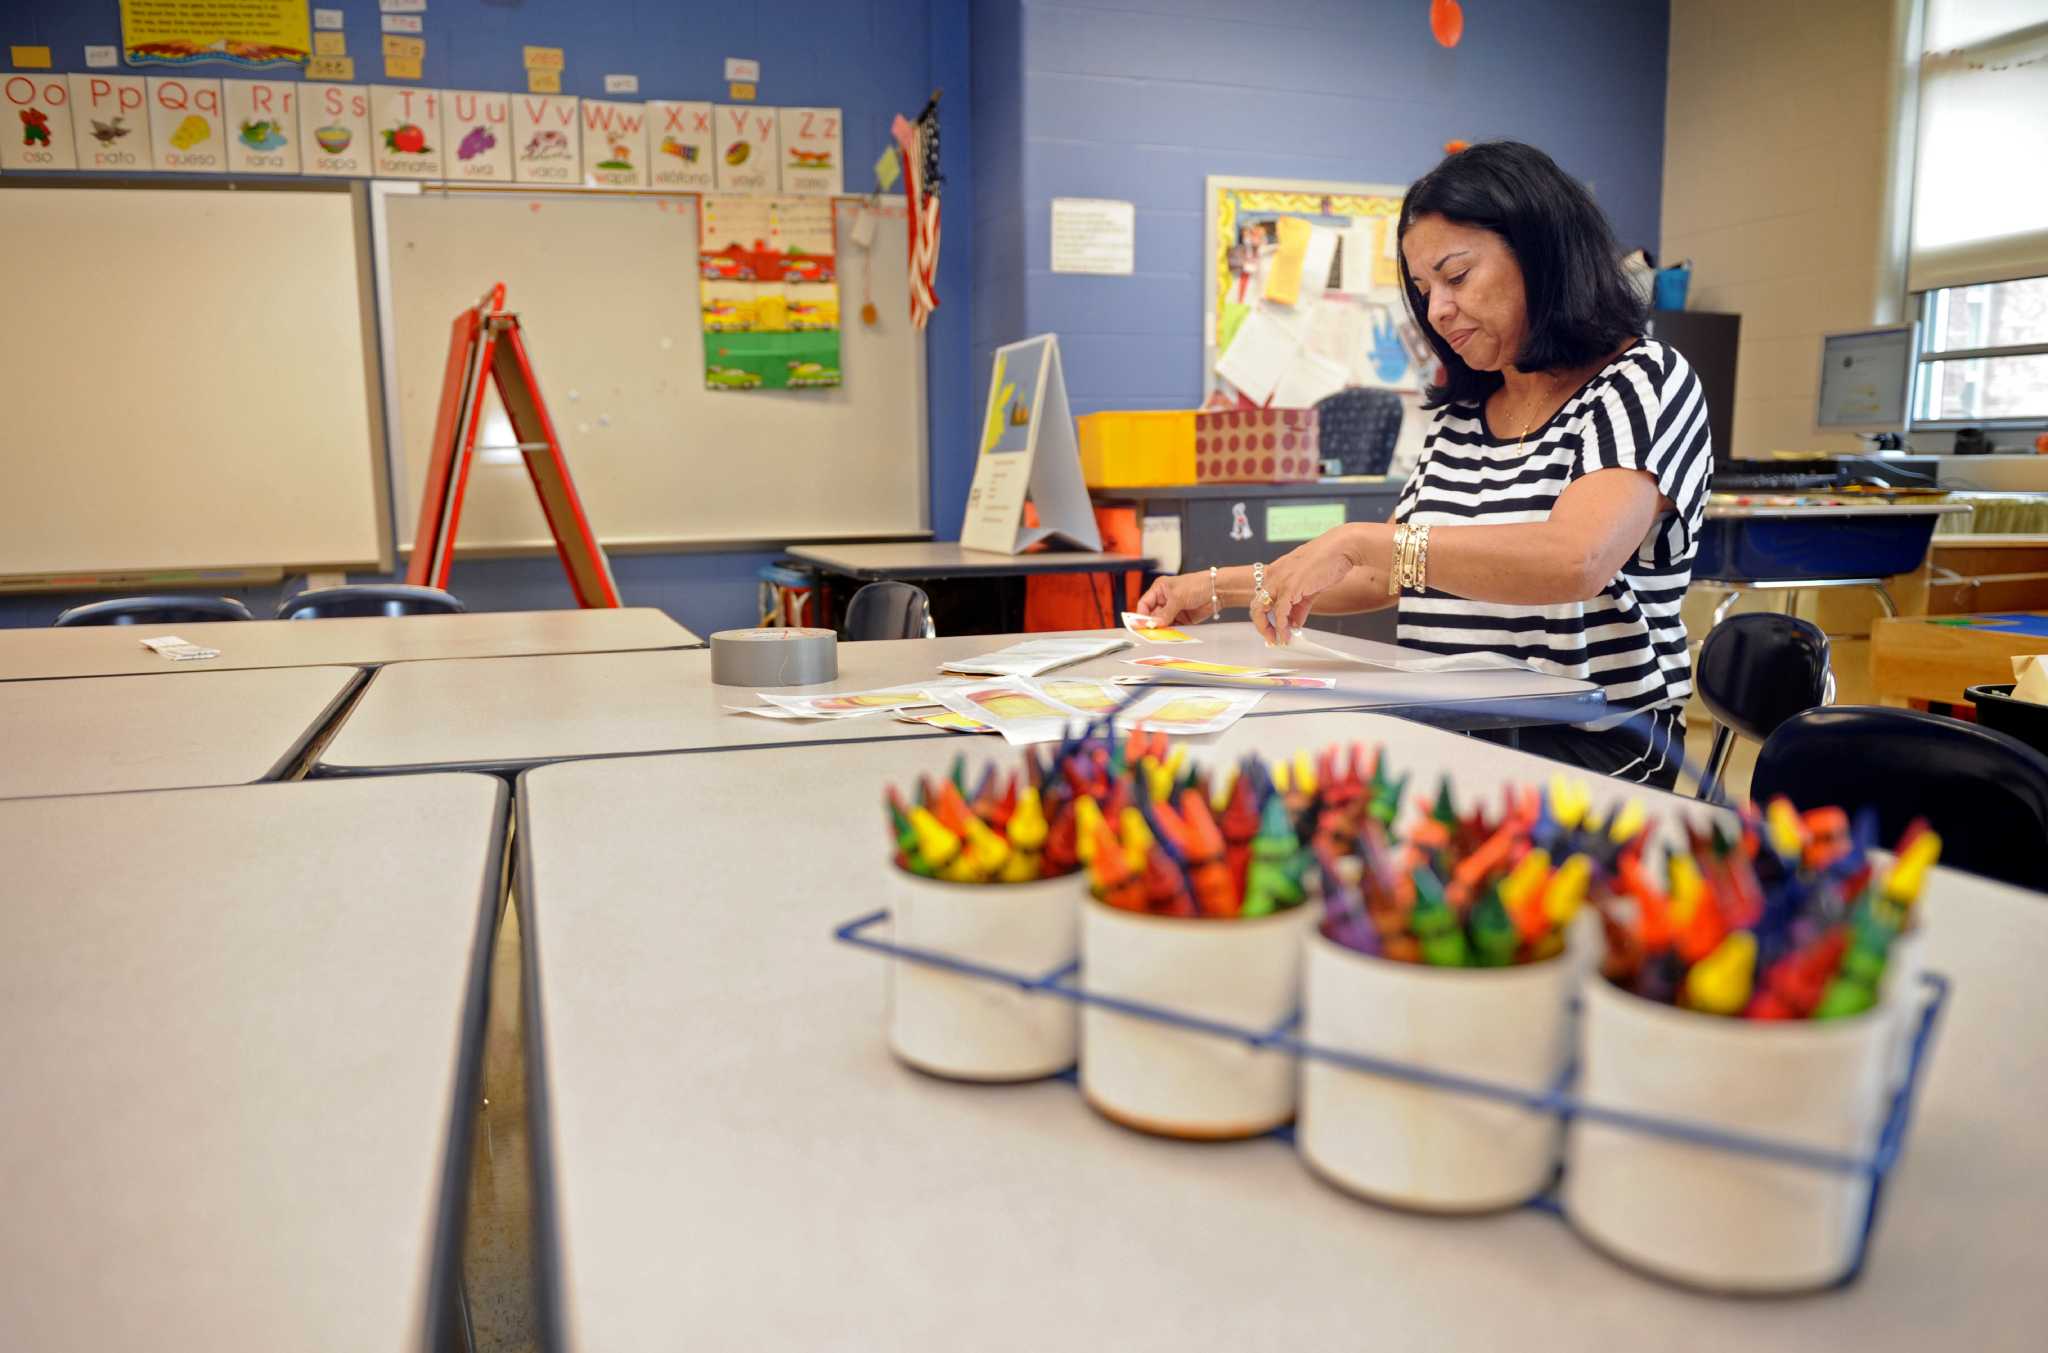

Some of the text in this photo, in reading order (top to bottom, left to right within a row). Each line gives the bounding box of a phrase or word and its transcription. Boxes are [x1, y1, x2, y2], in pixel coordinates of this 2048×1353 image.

[24, 151, 53, 163] oso
[96, 152, 136, 167] pato
[165, 154, 216, 168] queso
[245, 154, 284, 167] rana
[379, 159, 439, 173] tomate
[528, 167, 569, 177] vaca
